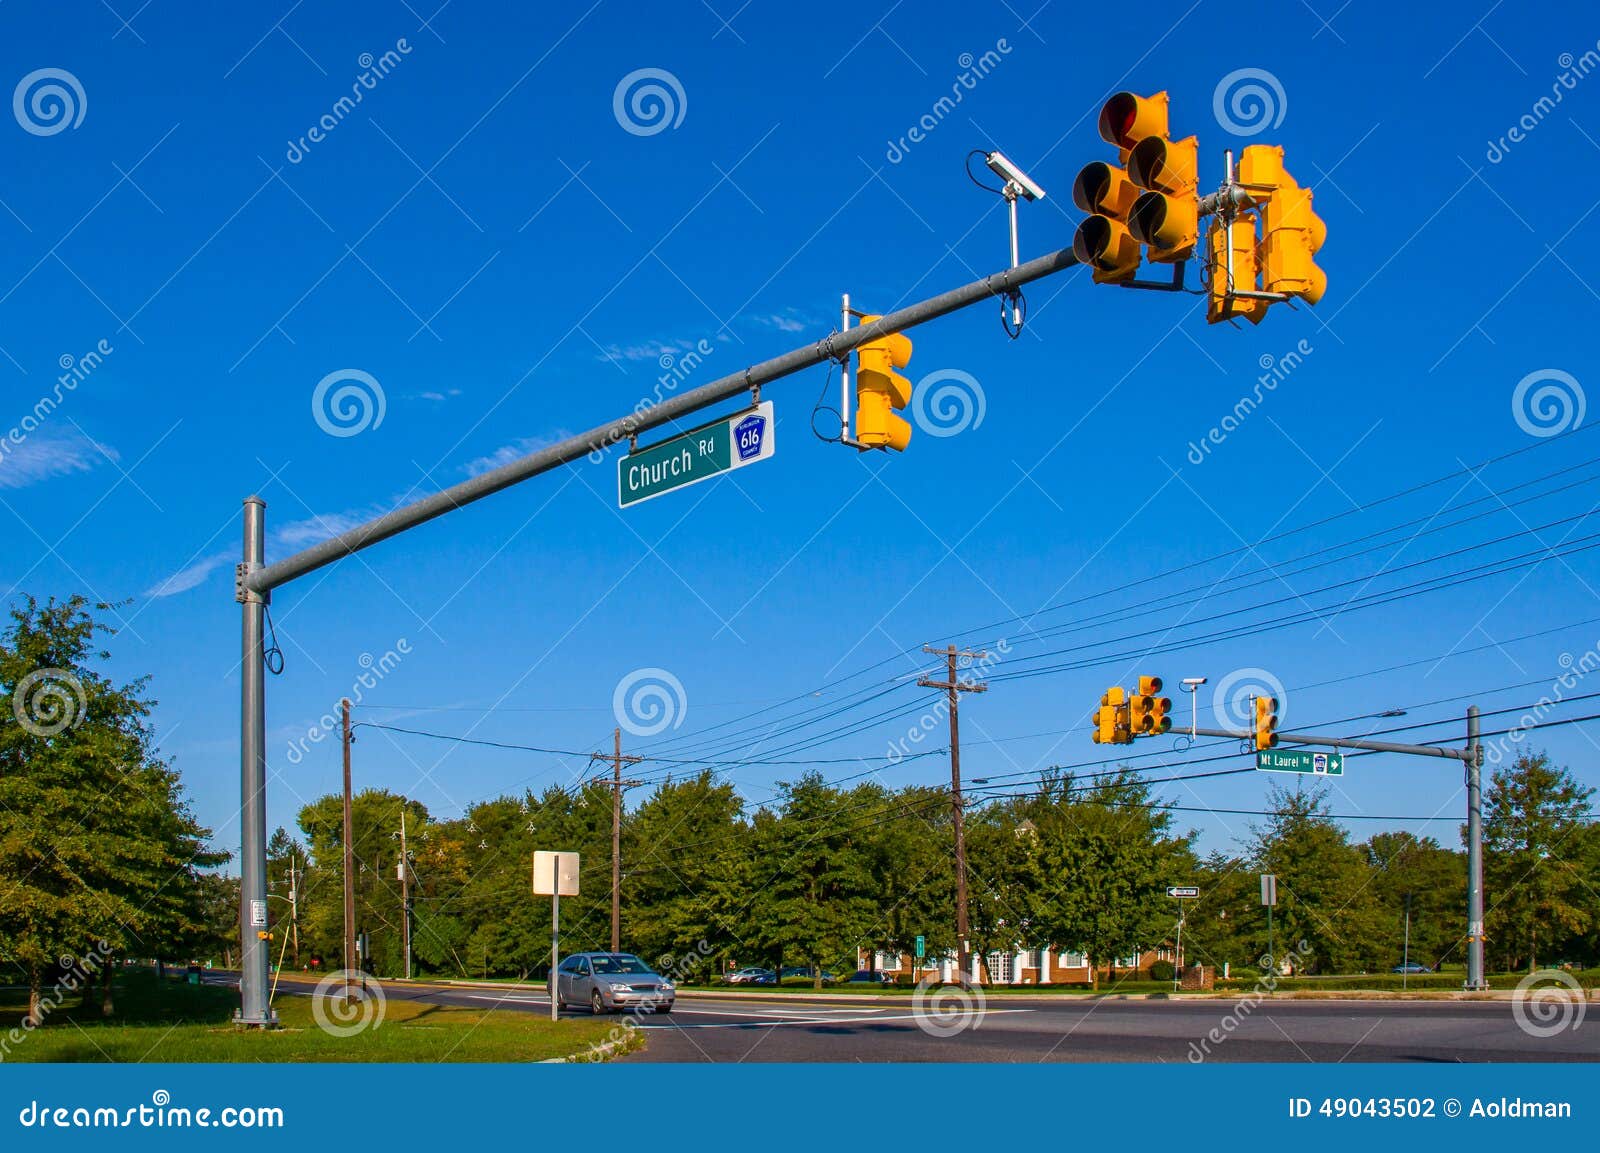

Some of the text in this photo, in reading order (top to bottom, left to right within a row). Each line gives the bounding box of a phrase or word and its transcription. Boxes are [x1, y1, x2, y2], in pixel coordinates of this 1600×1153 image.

[741, 428, 760, 449] 616
[628, 437, 714, 491] Church Rd
[1261, 753, 1271, 765] Mt
[1274, 754, 1298, 767] Laurel
